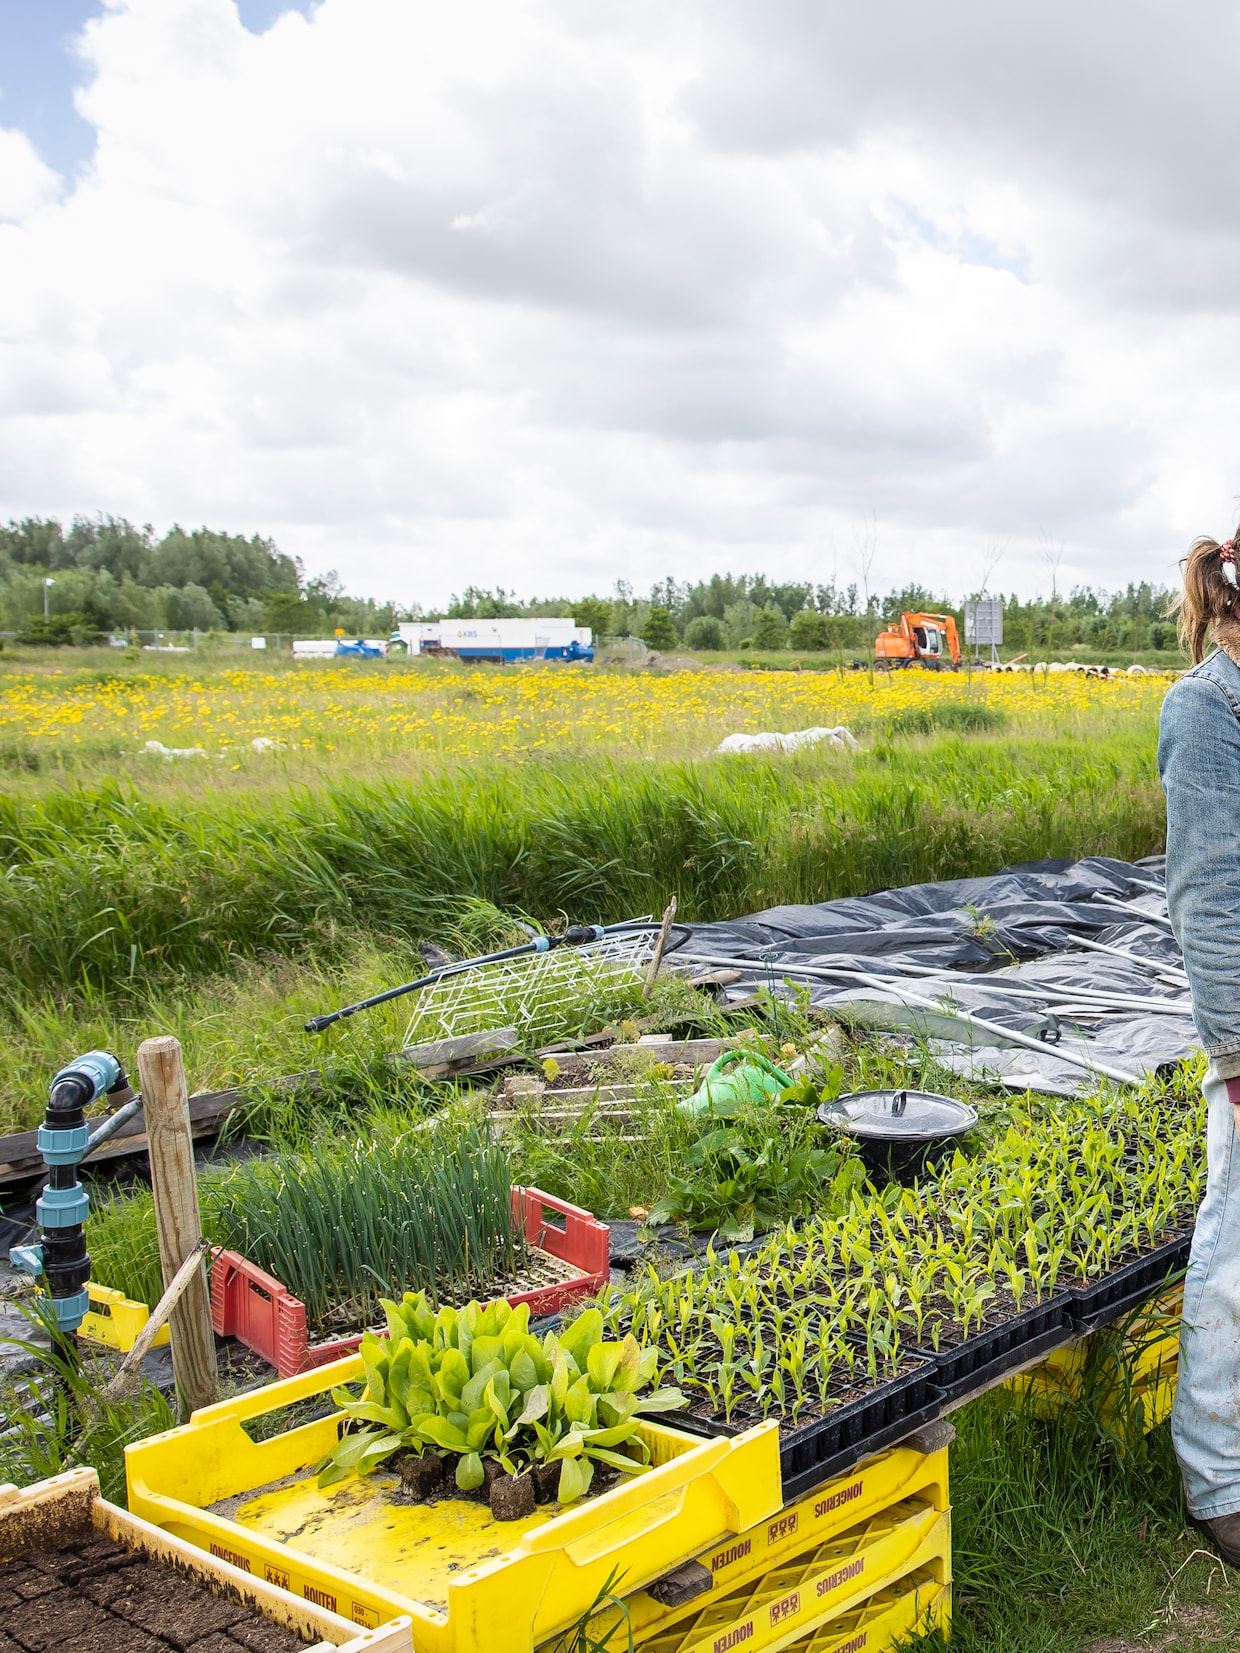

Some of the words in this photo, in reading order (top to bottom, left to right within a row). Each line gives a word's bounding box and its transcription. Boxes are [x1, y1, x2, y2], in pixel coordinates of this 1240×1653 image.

[814, 1480, 863, 1518] JONGERIUS
[711, 1539, 751, 1572] HOUTEN
[209, 1543, 251, 1573] JONGERIUS
[303, 1584, 337, 1613] HOUTEN
[816, 1557, 865, 1597] JONGERIUS
[713, 1621, 753, 1653] HOUTEN
